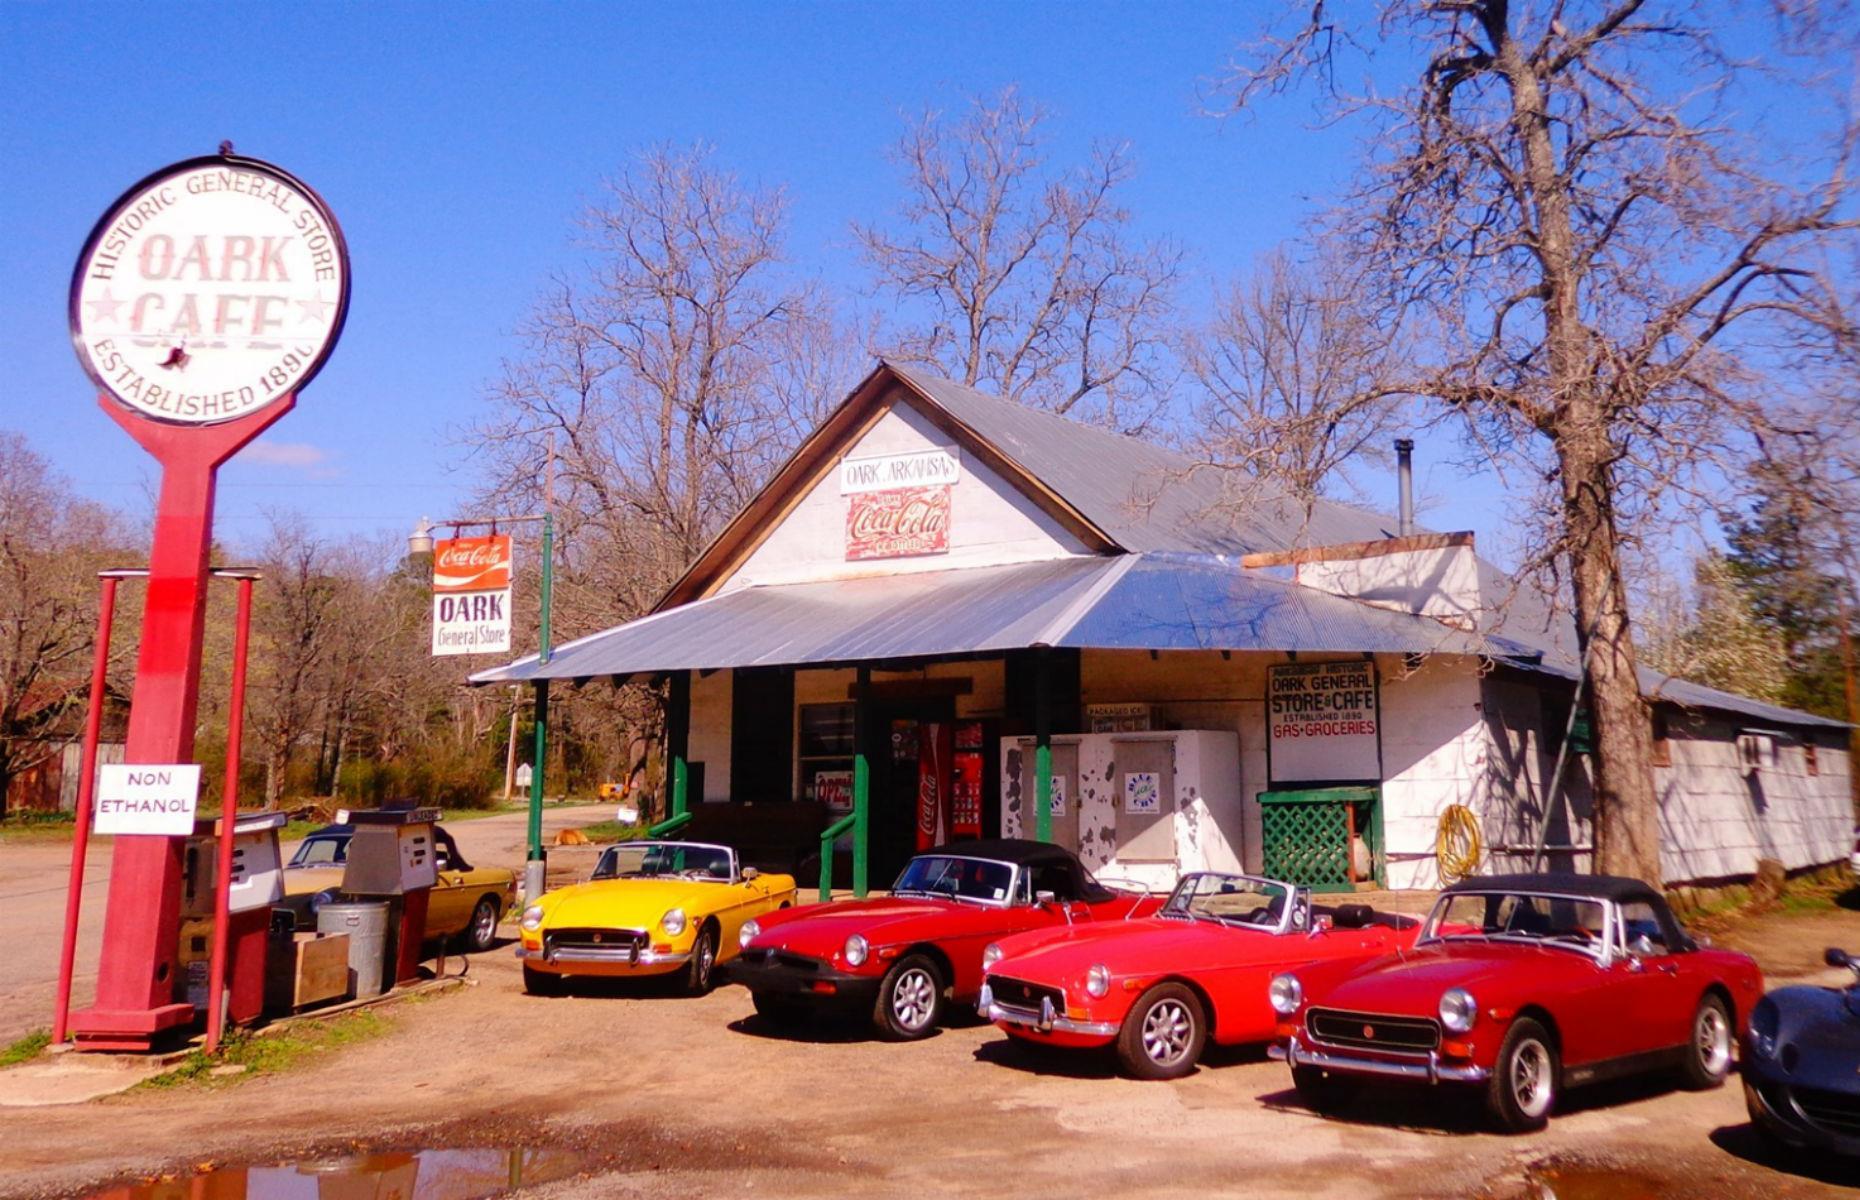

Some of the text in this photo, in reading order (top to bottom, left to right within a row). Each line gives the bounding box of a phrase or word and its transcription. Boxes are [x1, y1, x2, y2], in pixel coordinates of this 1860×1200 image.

[91, 171, 335, 283] HISTORIC GENERAL STORE
[138, 233, 294, 282] OARK
[130, 292, 289, 350] CAFE
[94, 338, 255, 416] ESTABLISHED
[888, 456, 956, 482] ARKANSAS
[440, 594, 504, 622] OARK
[438, 625, 506, 647] General Store
[1272, 674, 1373, 693] OARK GENERAL
[1272, 692, 1324, 713] STORE
[1333, 690, 1374, 711] CAFE
[1283, 713, 1338, 722] ESTABLISHED
[1305, 721, 1376, 737] GROCERIES
[128, 772, 171, 786] NON
[100, 799, 190, 813] ETHANOL
